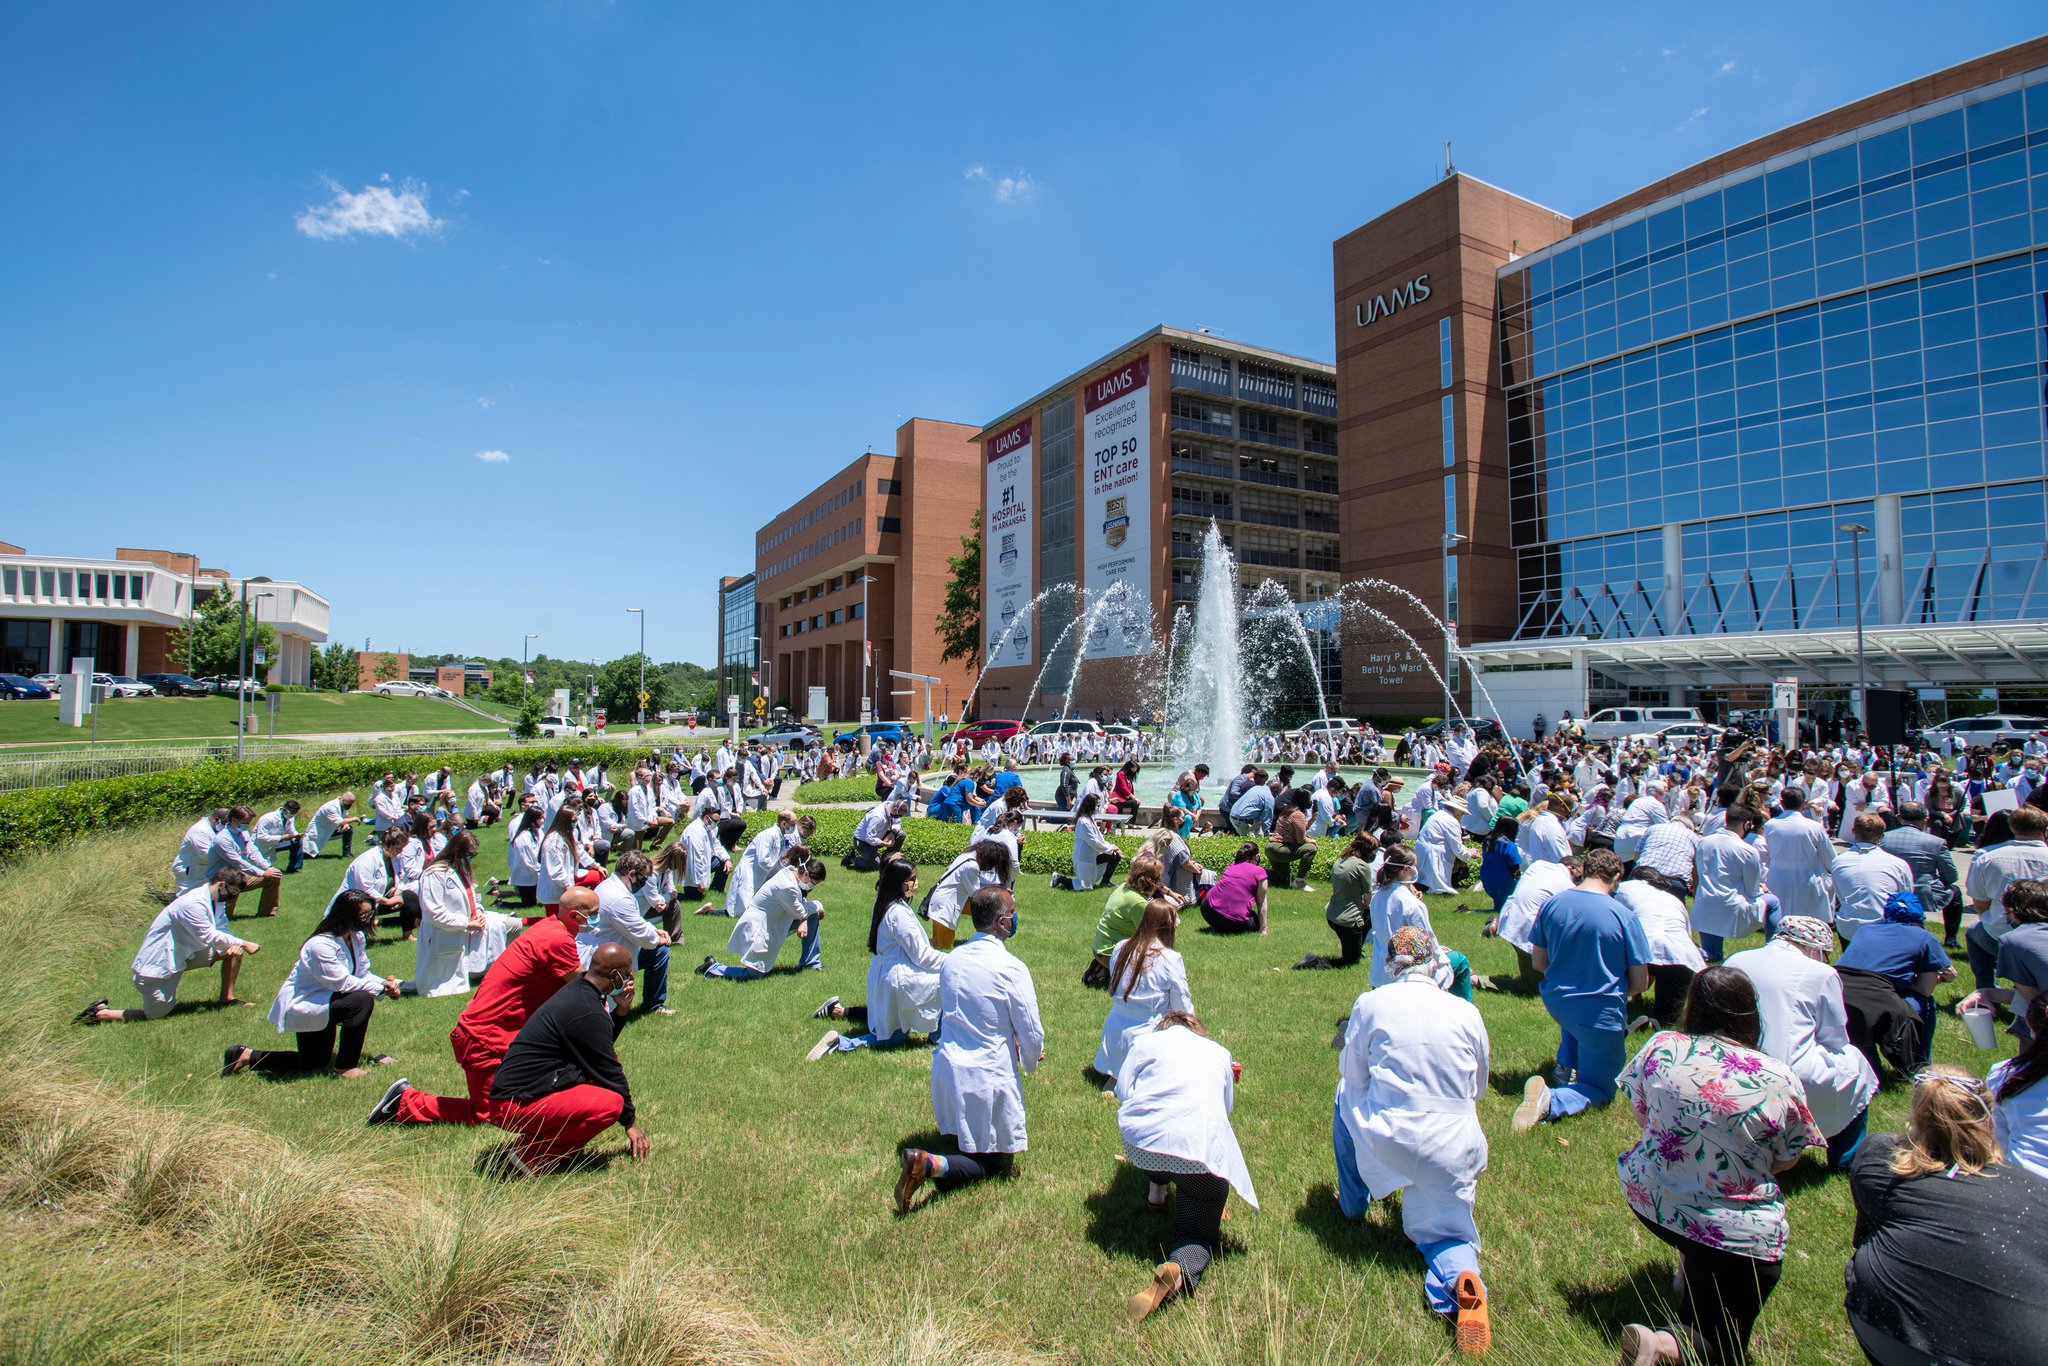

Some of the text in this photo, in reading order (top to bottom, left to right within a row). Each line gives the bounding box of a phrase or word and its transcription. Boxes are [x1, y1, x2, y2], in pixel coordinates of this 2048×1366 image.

[1356, 274, 1431, 327] UAMS
[1097, 368, 1133, 401] UAMS
[1095, 399, 1136, 426] Excellence
[1094, 411, 1137, 440] recognized
[996, 428, 1021, 453] UAMS
[1095, 437, 1137, 467] TOP 50
[997, 455, 1021, 472] Proud to
[1094, 457, 1139, 483] ENT care
[1000, 467, 1017, 482] be the
[1094, 471, 1138, 495] in the nation!
[1002, 485, 1015, 506] #1
[1106, 496, 1125, 512] BEST
[992, 502, 1026, 523] HOSPITAL
[992, 513, 1027, 533] IN ARKANSAS
[1105, 568, 1117, 576] CARE
[1108, 557, 1136, 568] PERFORMING
[1370, 651, 1412, 663] Harry P. &
[1362, 663, 1422, 675] Betty Jo Ward
[1379, 676, 1404, 685] Tower
[1779, 684, 1797, 693] Parking
[1786, 693, 1791, 707] 1
